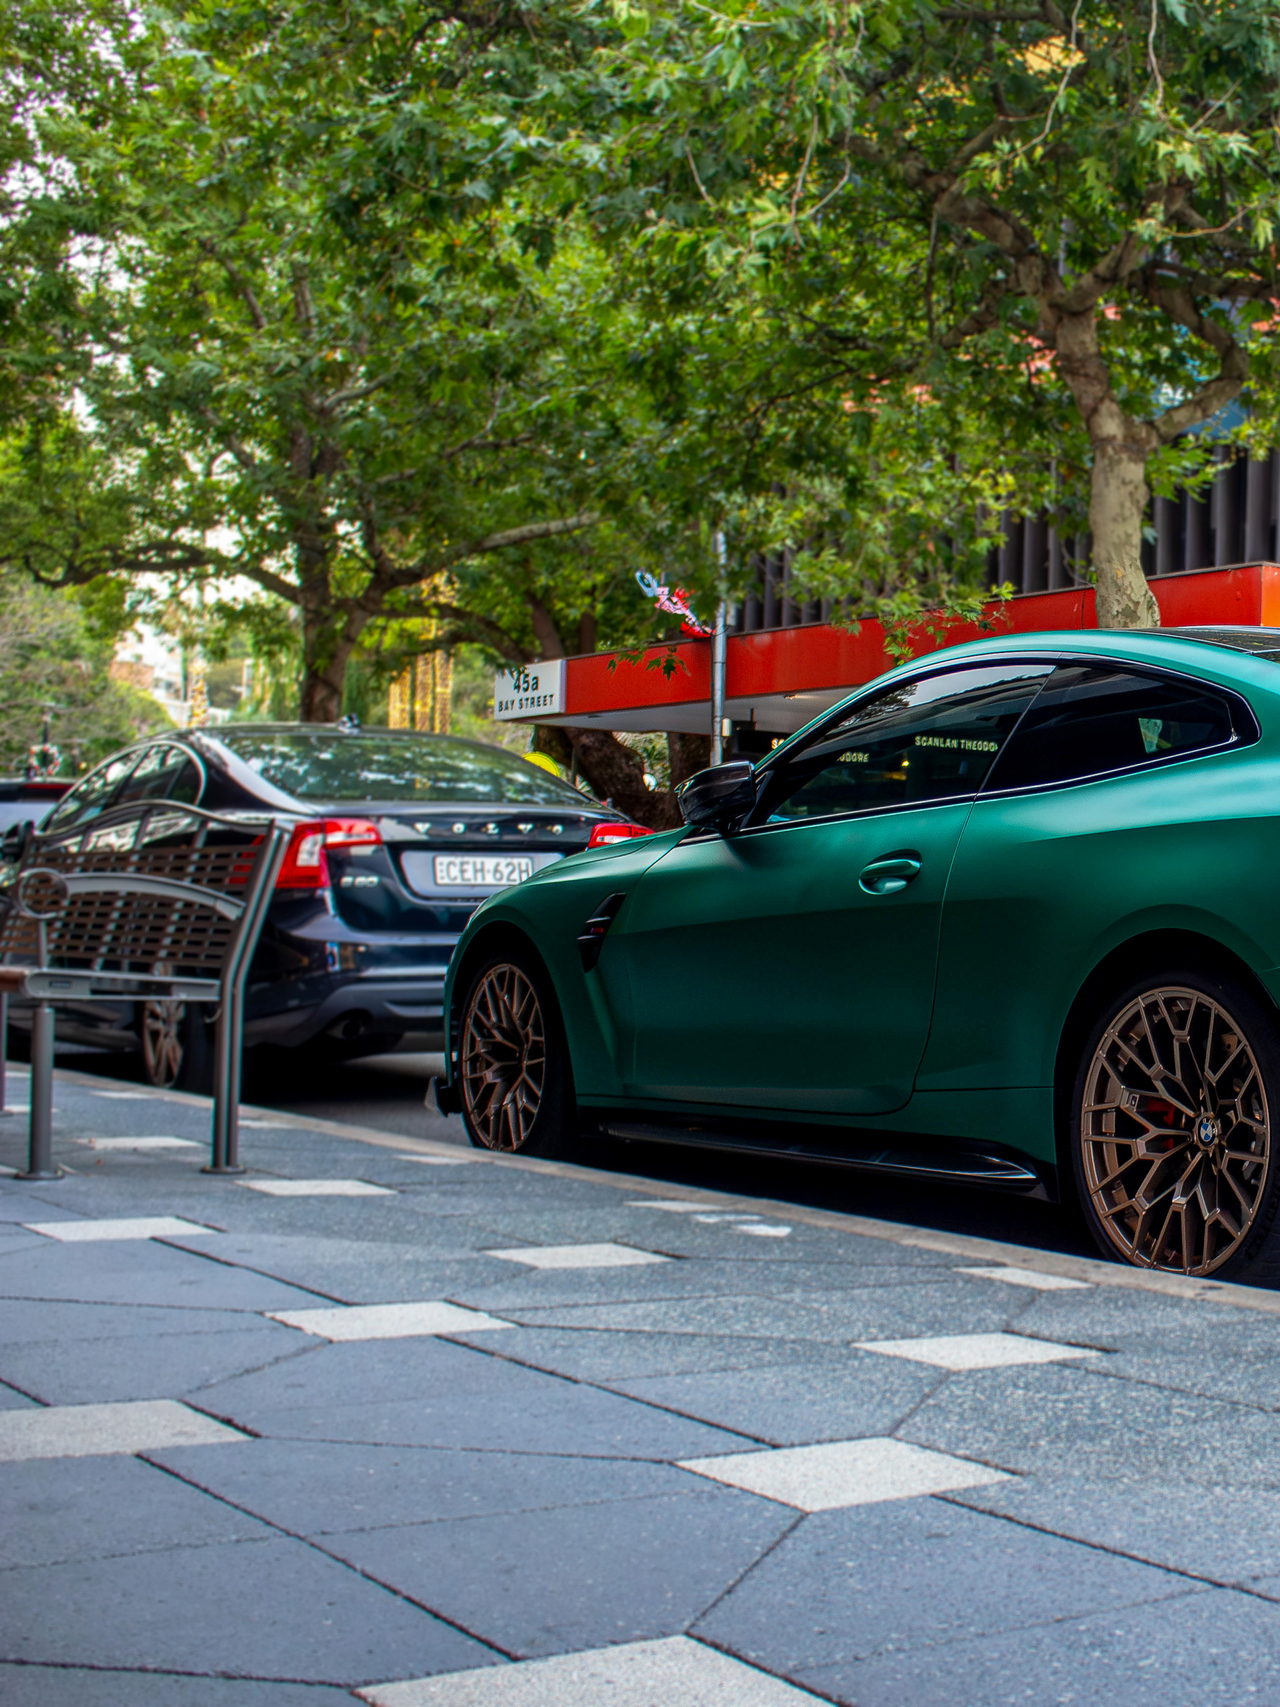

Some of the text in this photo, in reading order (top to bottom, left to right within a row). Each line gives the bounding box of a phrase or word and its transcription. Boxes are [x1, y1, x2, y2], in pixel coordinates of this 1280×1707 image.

[513, 673, 540, 693] 45a
[498, 694, 554, 712] BAY STREET
[915, 736, 958, 749] SCANLAN
[413, 822, 563, 835] VOLVO
